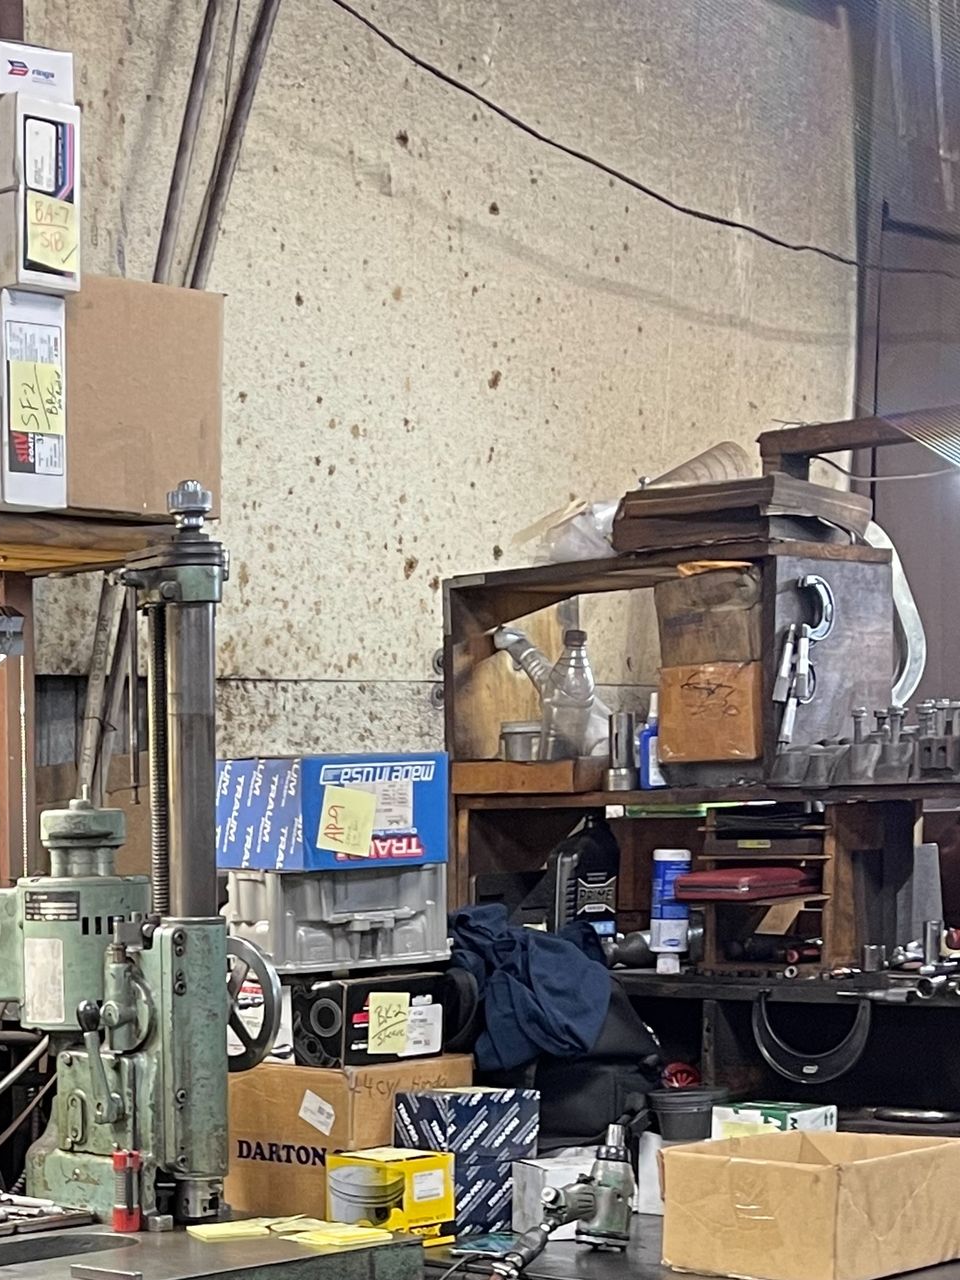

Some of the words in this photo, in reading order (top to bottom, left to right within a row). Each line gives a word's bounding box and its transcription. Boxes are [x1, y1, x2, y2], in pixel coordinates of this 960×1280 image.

[34, 201, 70, 224] BA-7
[229, 775, 245, 842] TRAUM
[263, 774, 279, 843] TRAUM
[374, 1003, 407, 1027] BK-2
[238, 1139, 327, 1167] DARTON
